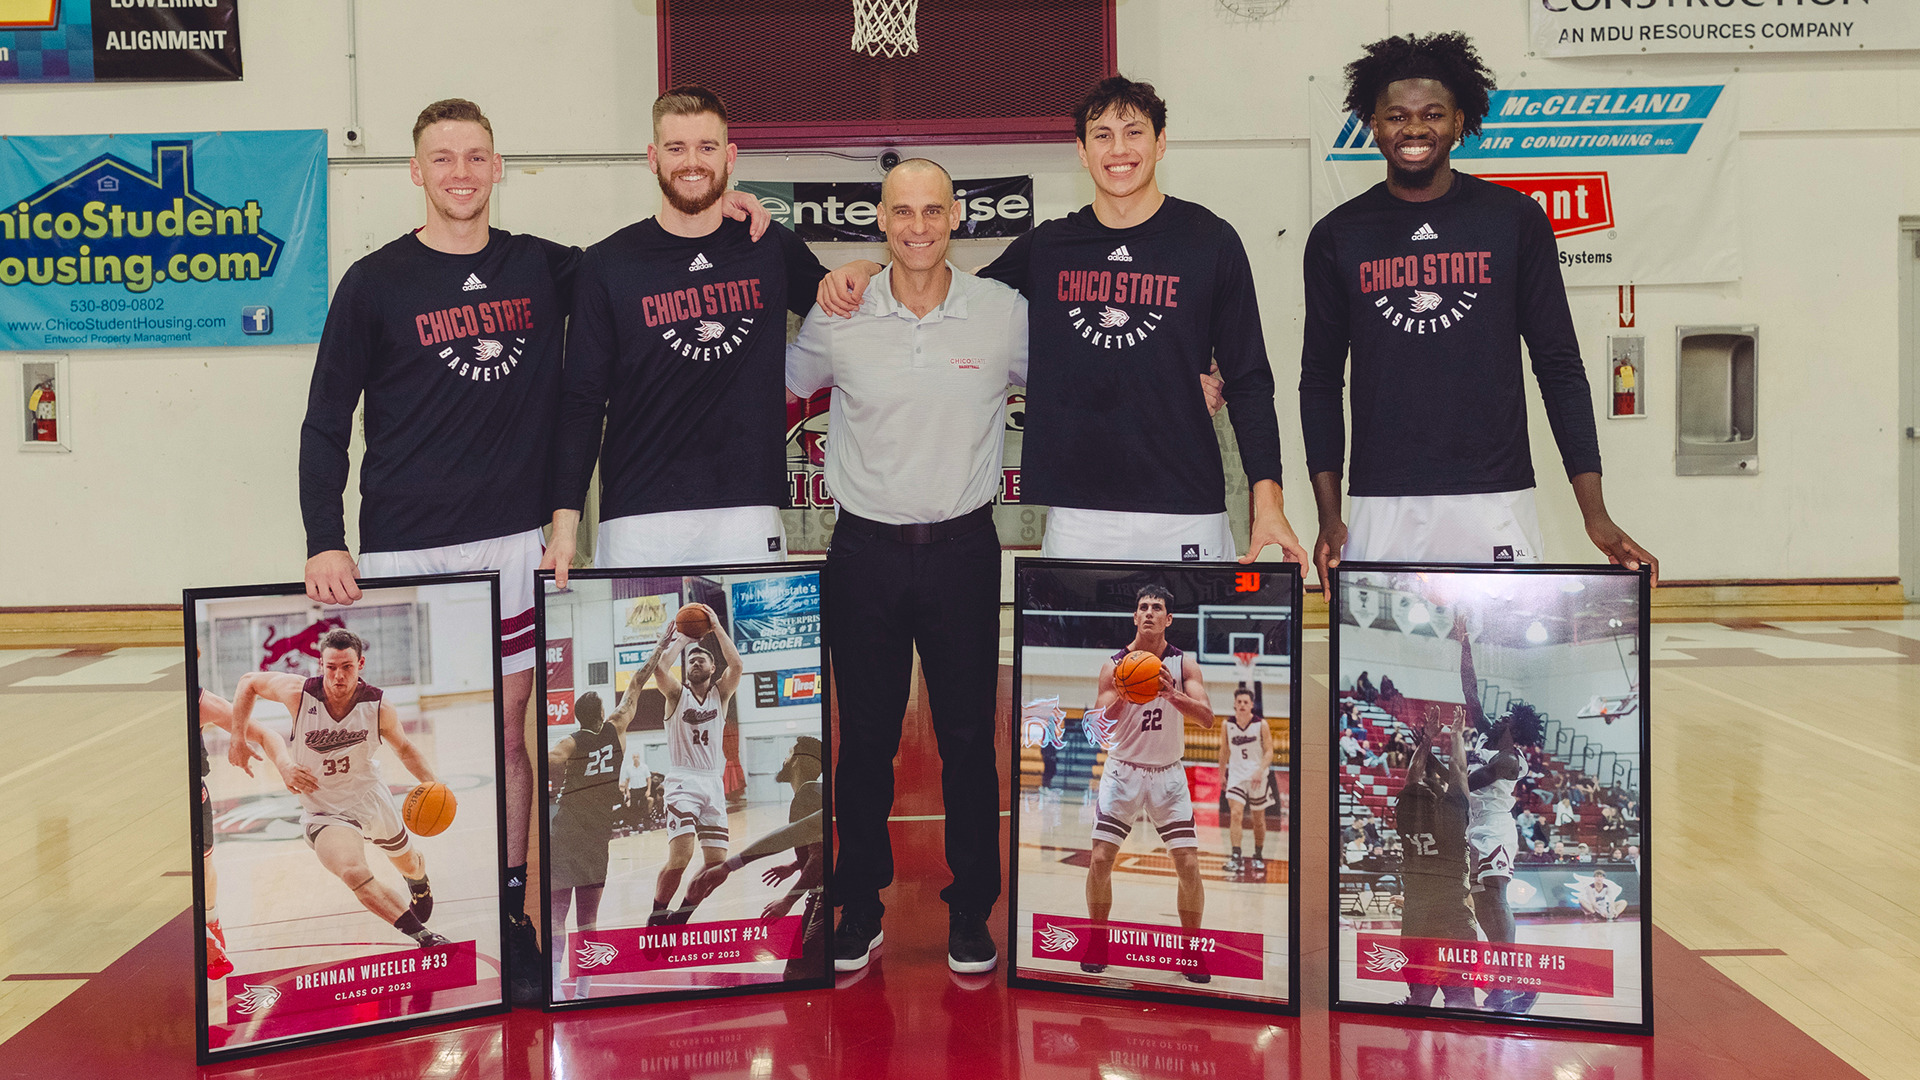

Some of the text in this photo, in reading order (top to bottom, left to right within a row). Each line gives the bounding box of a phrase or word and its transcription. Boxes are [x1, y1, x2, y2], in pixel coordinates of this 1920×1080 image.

[105, 30, 227, 50] ALIGNMENT
[1558, 21, 1854, 44] AN MDU RESOURCES COMPANY
[1500, 93, 1691, 117] McCLELLAND
[1479, 136, 1514, 150] AIR
[1520, 134, 1653, 149] CONDITIONING
[759, 188, 1030, 226] enteise
[1411, 233, 1439, 241] adidas
[688, 262, 713, 272] adidas
[1107, 254, 1133, 262] adidas
[1559, 251, 1613, 267] Systems
[1359, 251, 1492, 294] CHICO STATE
[461, 283, 487, 292] adidas
[1058, 270, 1180, 308] CHICO STATE
[69, 298, 165, 313] 530-809-0802
[641, 278, 764, 328] CHICO STATE
[1375, 290, 1478, 334] BASKETBALL
[7, 316, 226, 332] www.ChicoStudentHousing.com
[415, 298, 534, 346] CHICO STATE
[1068, 307, 1163, 349] BASKETBALL
[44, 332, 192, 346] Entwood Property Managment
[662, 317, 754, 362] BASKETBALL
[438, 337, 526, 382] BASKETBALL
[1141, 708, 1163, 732] 22
[692, 729, 709, 746] 24
[584, 744, 614, 776] 22
[1241, 748, 1248, 760] 5
[323, 756, 351, 777] 33
[639, 925, 768, 950] DYLAN BELQUIST #24
[1108, 928, 1216, 953] JUSTIN VIGIL #22
[667, 950, 741, 963] CLASS OF 2023
[1126, 953, 1198, 967] CLASS OF 2023
[1438, 947, 1565, 970] KALEB CARTER #15
[296, 952, 448, 991] BRENNAN WHEELER #33
[1461, 972, 1541, 986] CLASS OF 2023
[334, 981, 412, 1001] CLASS OF 2023
